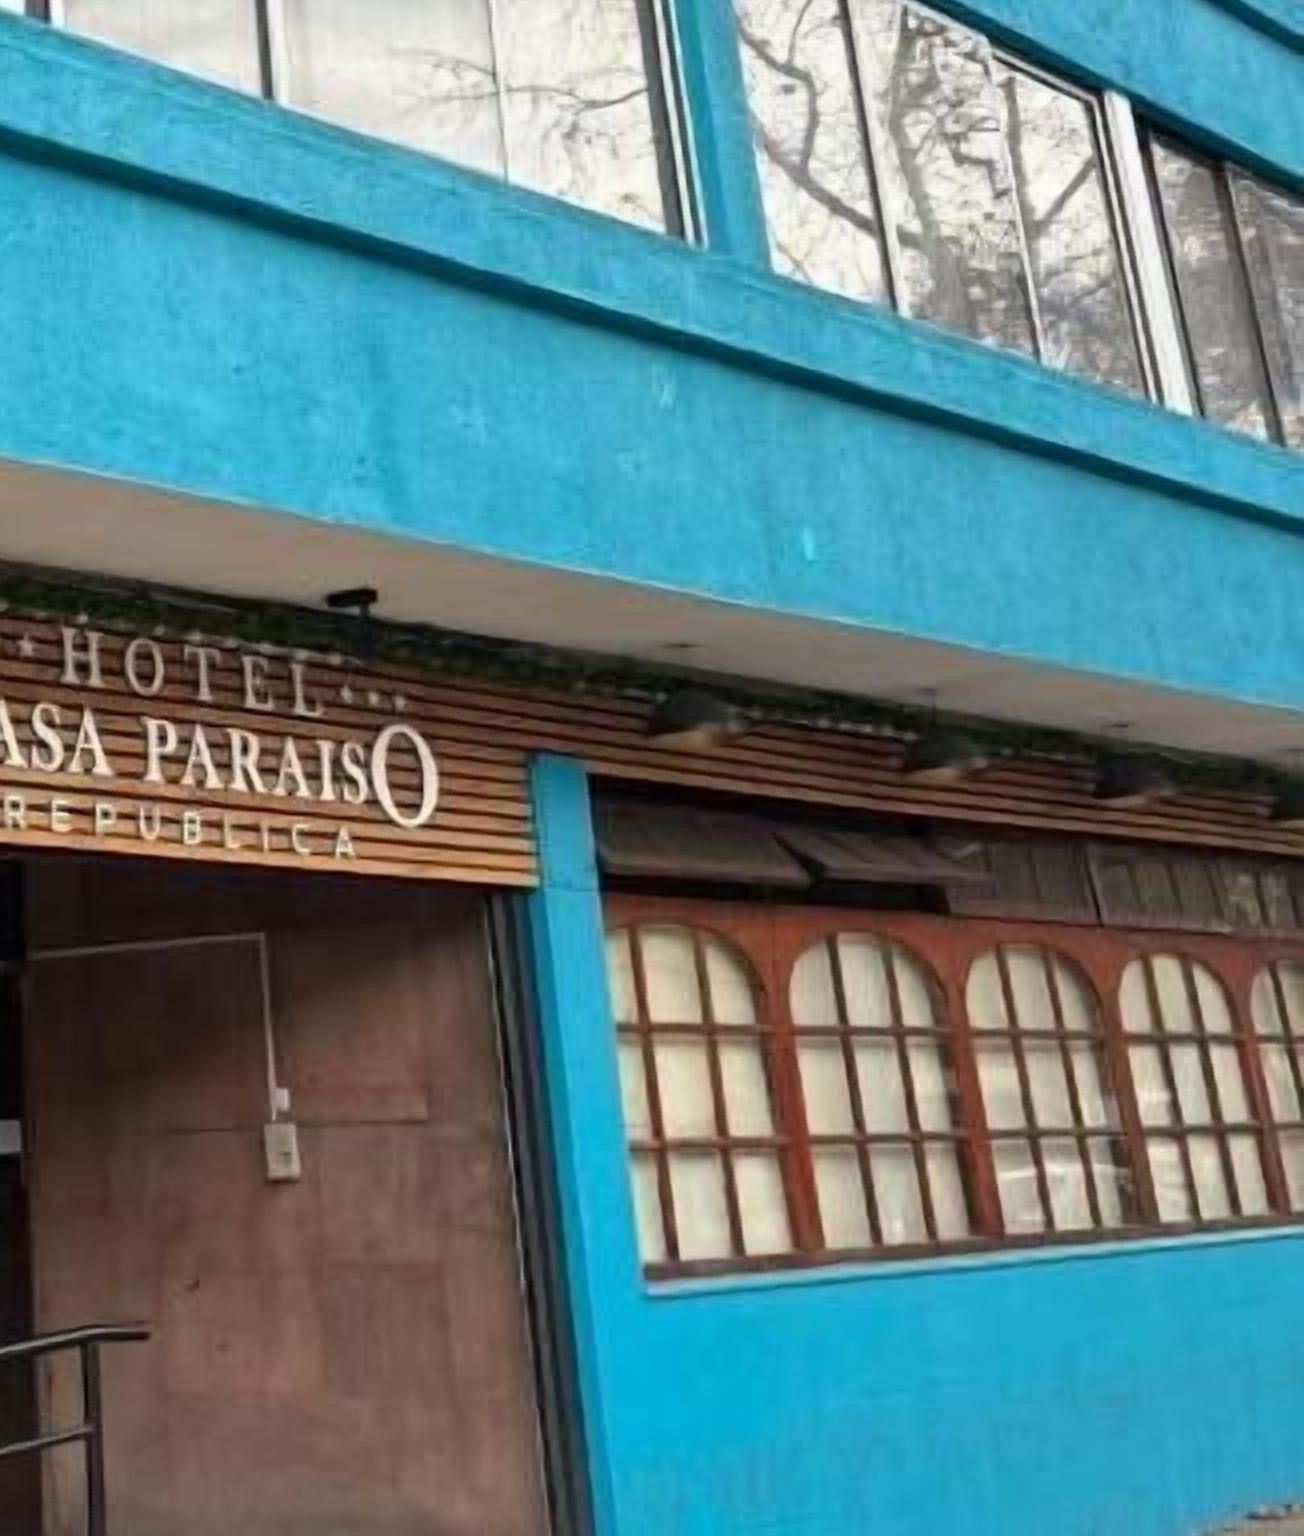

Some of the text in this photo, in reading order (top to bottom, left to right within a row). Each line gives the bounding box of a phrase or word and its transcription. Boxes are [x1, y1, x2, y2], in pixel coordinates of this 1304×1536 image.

[59, 626, 327, 718] HOTEL
[140, 715, 440, 829] PARAISO
[2, 794, 358, 860] REPUBLICA
